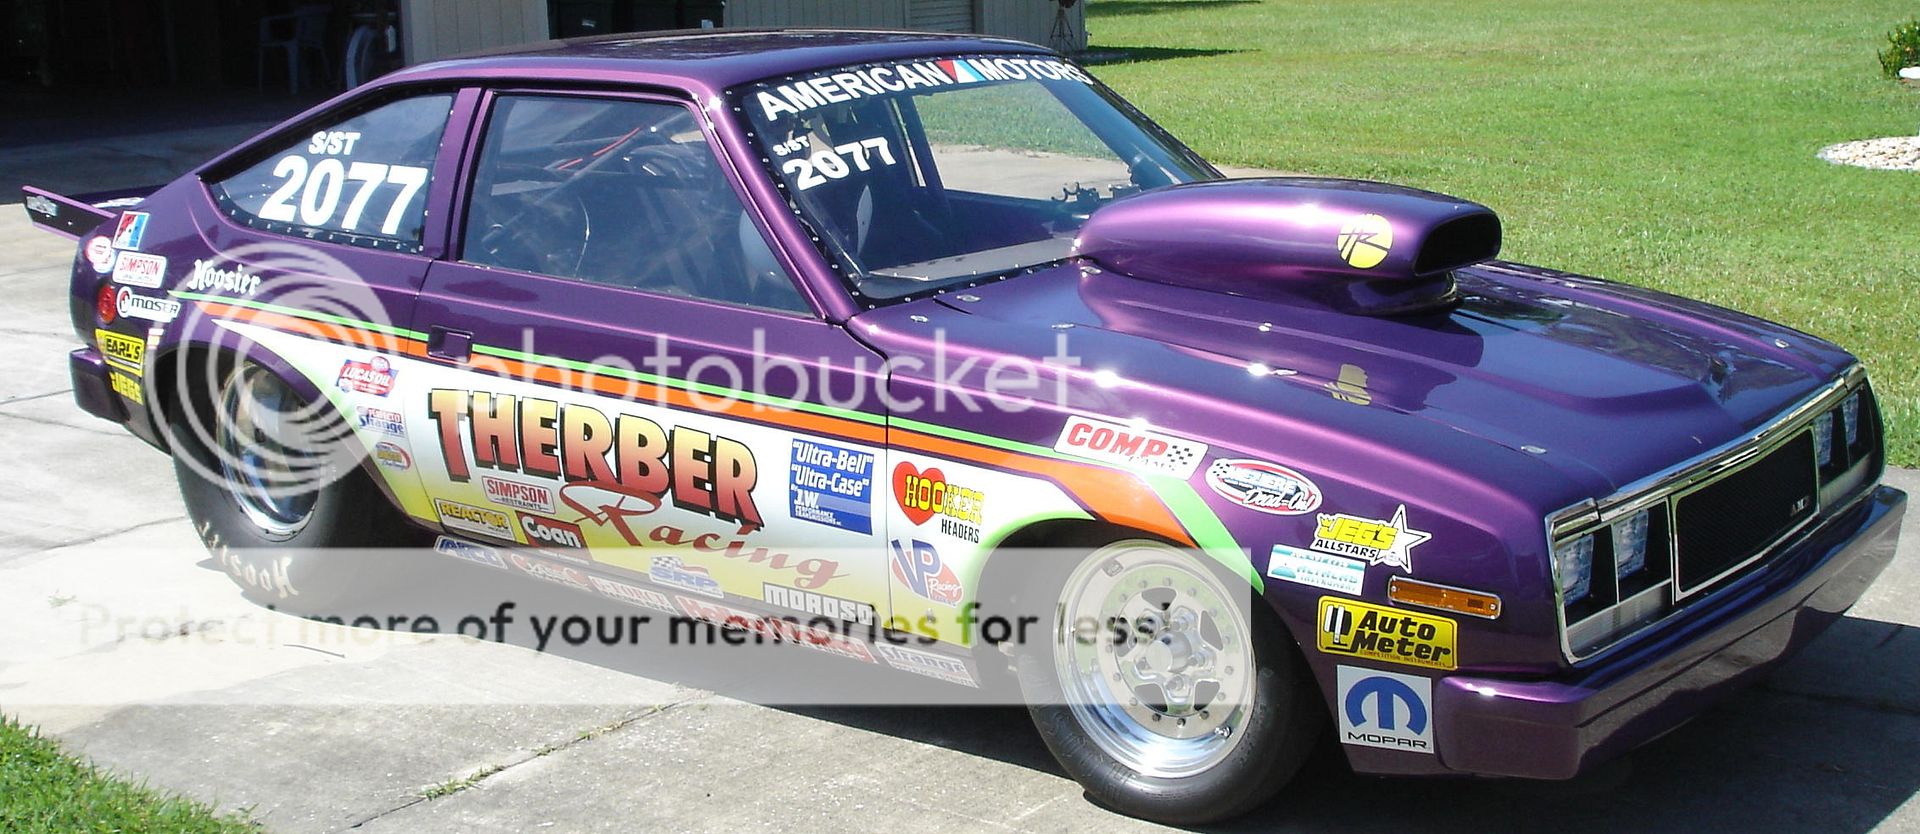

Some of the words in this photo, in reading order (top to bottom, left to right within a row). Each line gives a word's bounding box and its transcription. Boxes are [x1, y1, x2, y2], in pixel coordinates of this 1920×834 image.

[756, 60, 954, 122] AMERICAN
[967, 58, 1094, 86] MOTORS
[308, 130, 362, 155] S/ST
[772, 136, 811, 157] S/ST
[782, 136, 896, 191] 2077
[258, 155, 428, 235] 2077
[119, 257, 160, 275] SIMPSON
[187, 259, 261, 295] Hoosier
[106, 338, 141, 360] EARL'S
[1067, 423, 1168, 458] COMP
[428, 388, 765, 531] THERBER
[487, 479, 548, 504] SIMPSON
[904, 474, 985, 526] HOOKER
[440, 502, 508, 529] REACTOR
[521, 516, 581, 548] Coan
[560, 481, 849, 590] Racing
[941, 519, 980, 544] HEADERS
[1315, 539, 1377, 558] ALLSTARS
[650, 565, 719, 588] SRP
[891, 539, 940, 598] VP
[928, 578, 962, 598] Racing
[764, 583, 873, 626] MOROSO
[1358, 611, 1436, 640] Auto
[1350, 629, 1451, 661] Meter
[1347, 731, 1427, 748] MOPAR
